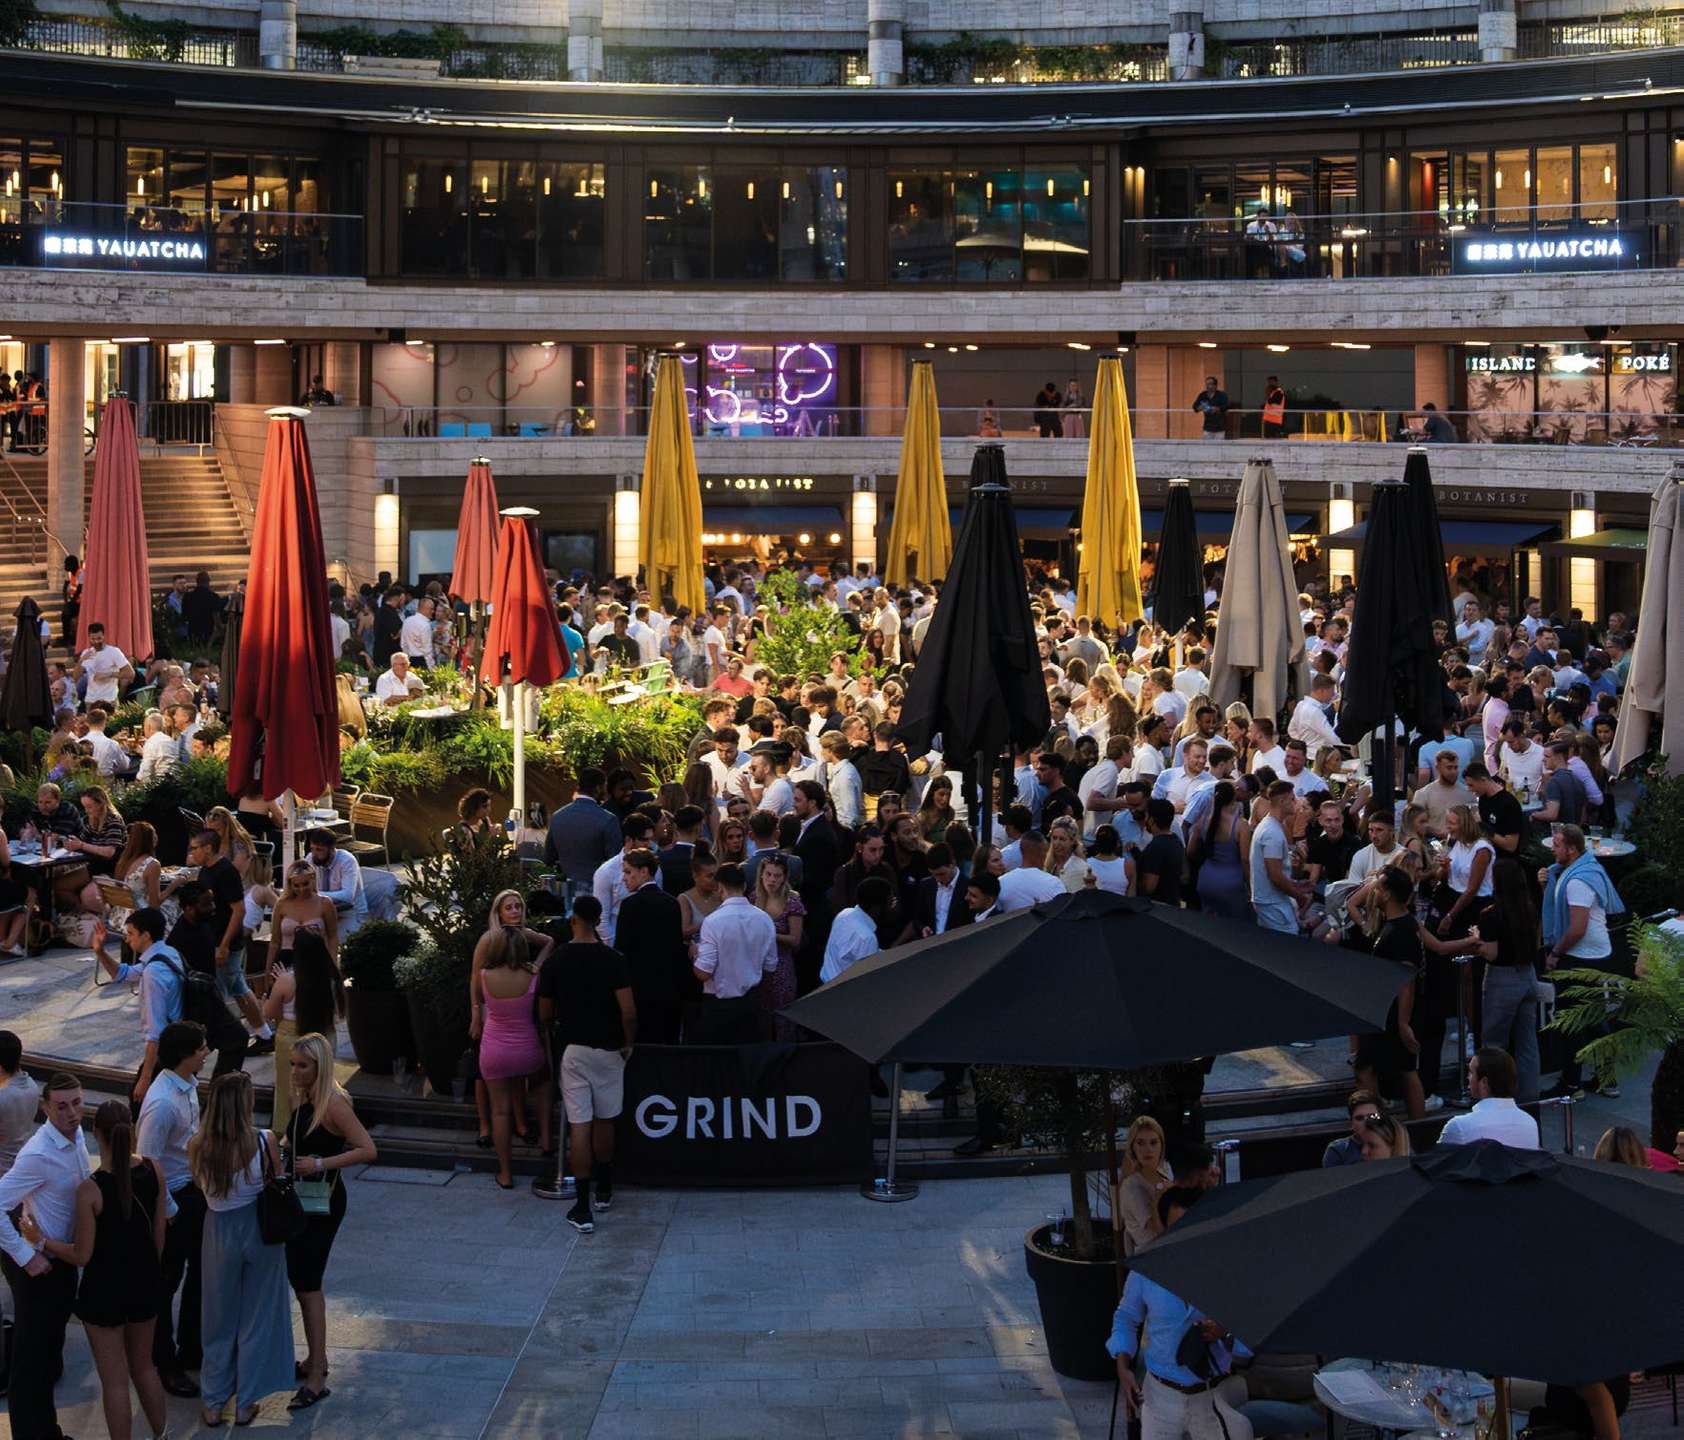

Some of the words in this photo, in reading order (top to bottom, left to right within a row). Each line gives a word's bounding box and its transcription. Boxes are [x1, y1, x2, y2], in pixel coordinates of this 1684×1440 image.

[98, 239, 203, 259] YAUATCHA
[1517, 239, 1622, 257] YAUATCHA
[1471, 357, 1536, 370] ISLAND
[1621, 353, 1669, 370] POKÉ
[1439, 490, 1528, 503] BOTANIST
[635, 1094, 822, 1139] GRIND
